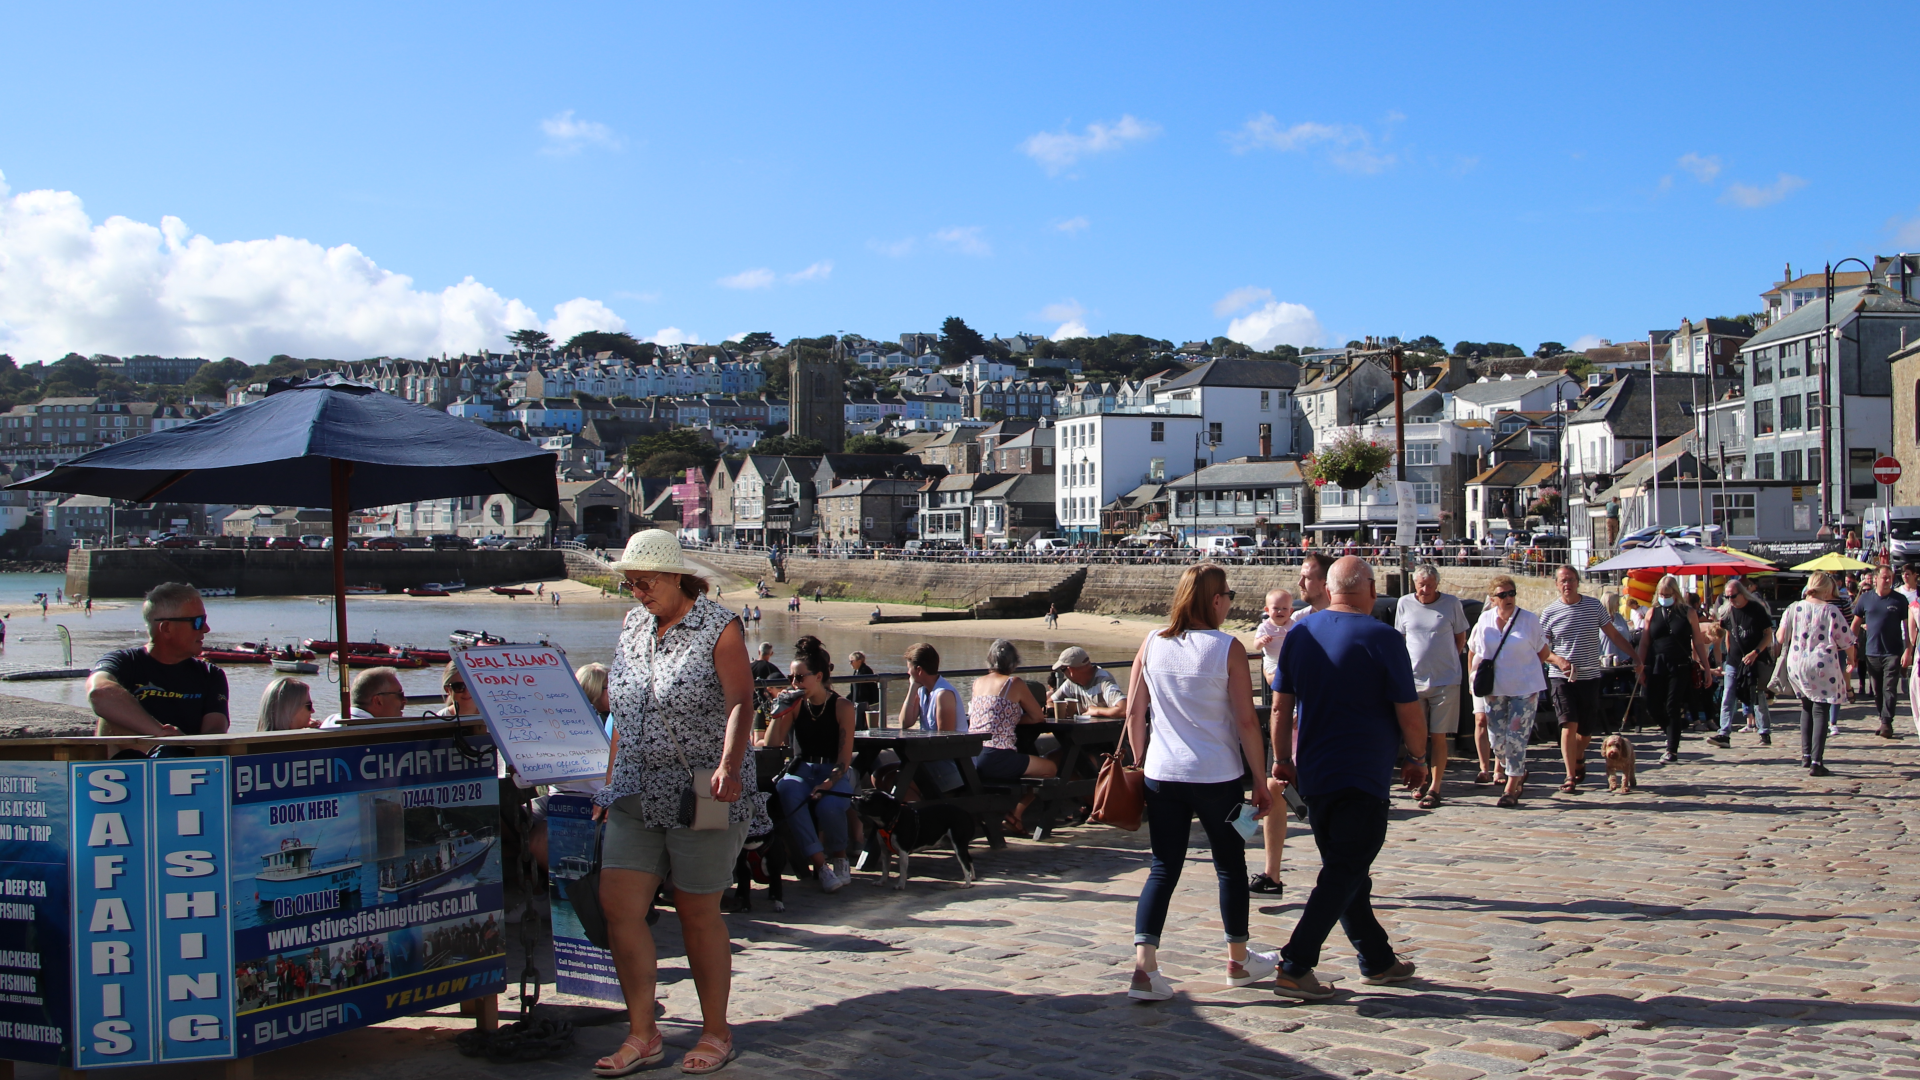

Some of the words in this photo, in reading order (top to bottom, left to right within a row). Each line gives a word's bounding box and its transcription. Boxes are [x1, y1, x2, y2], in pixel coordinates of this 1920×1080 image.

[464, 653, 503, 668] SEAL
[502, 653, 559, 667] ISLAND
[473, 673, 519, 686] TODAY
[143, 690, 201, 698] YELLOWFIN
[236, 757, 352, 793] BLUEFIN
[360, 744, 494, 780] CHARTERS
[522, 762, 553, 773] Booking
[20, 777, 37, 793] THE
[402, 788, 435, 809] 07444
[437, 787, 449, 805] 70
[452, 785, 465, 803] 29
[468, 783, 482, 801] 28
[0, 800, 11, 817] LS
[12, 800, 24, 817] AT
[25, 801, 48, 818] SEAL
[269, 802, 305, 826] BOOK
[308, 798, 339, 820] HERE
[549, 803, 579, 814] BLUEFIN
[13, 824, 29, 841] 1hr
[30, 825, 52, 842] TRIP
[5, 879, 28, 896] DEEP
[29, 880, 47, 897] SEA
[0, 902, 35, 921] FISHING
[88, 768, 133, 1055] SAFARIS
[165, 768, 220, 1042] FISHING
[274, 897, 293, 919] OR
[294, 888, 340, 915] ONLINE
[267, 891, 478, 950] www.stivesfishingtrips.co.uk
[0, 974, 36, 993] FISHING
[385, 968, 504, 1010] YELLOWFIN
[14, 1022, 62, 1044] CHARTERS
[254, 1003, 362, 1045] BLUEFIN
